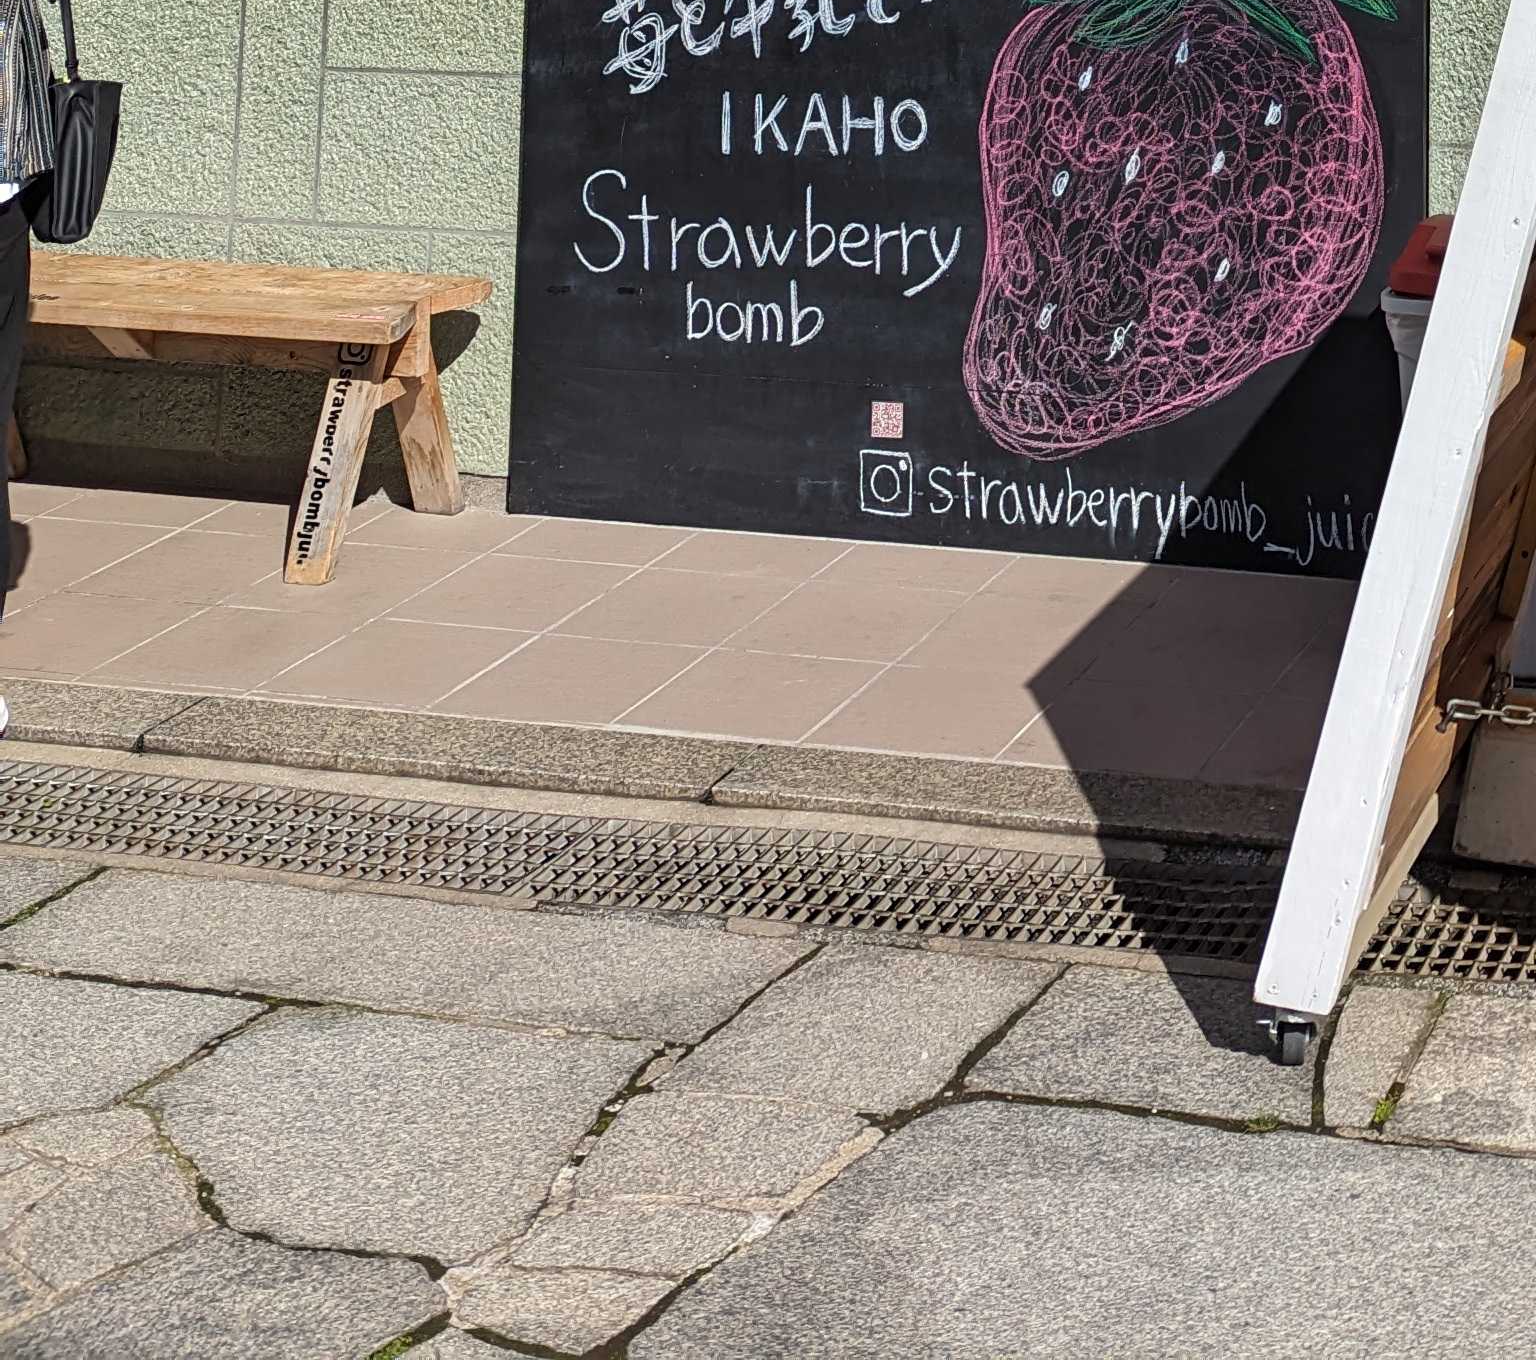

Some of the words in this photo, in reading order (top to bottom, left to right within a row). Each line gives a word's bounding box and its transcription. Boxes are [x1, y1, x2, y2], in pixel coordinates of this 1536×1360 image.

[721, 92, 929, 157] IKAHO
[573, 169, 963, 297] Strawberry
[685, 281, 825, 347] bomb
